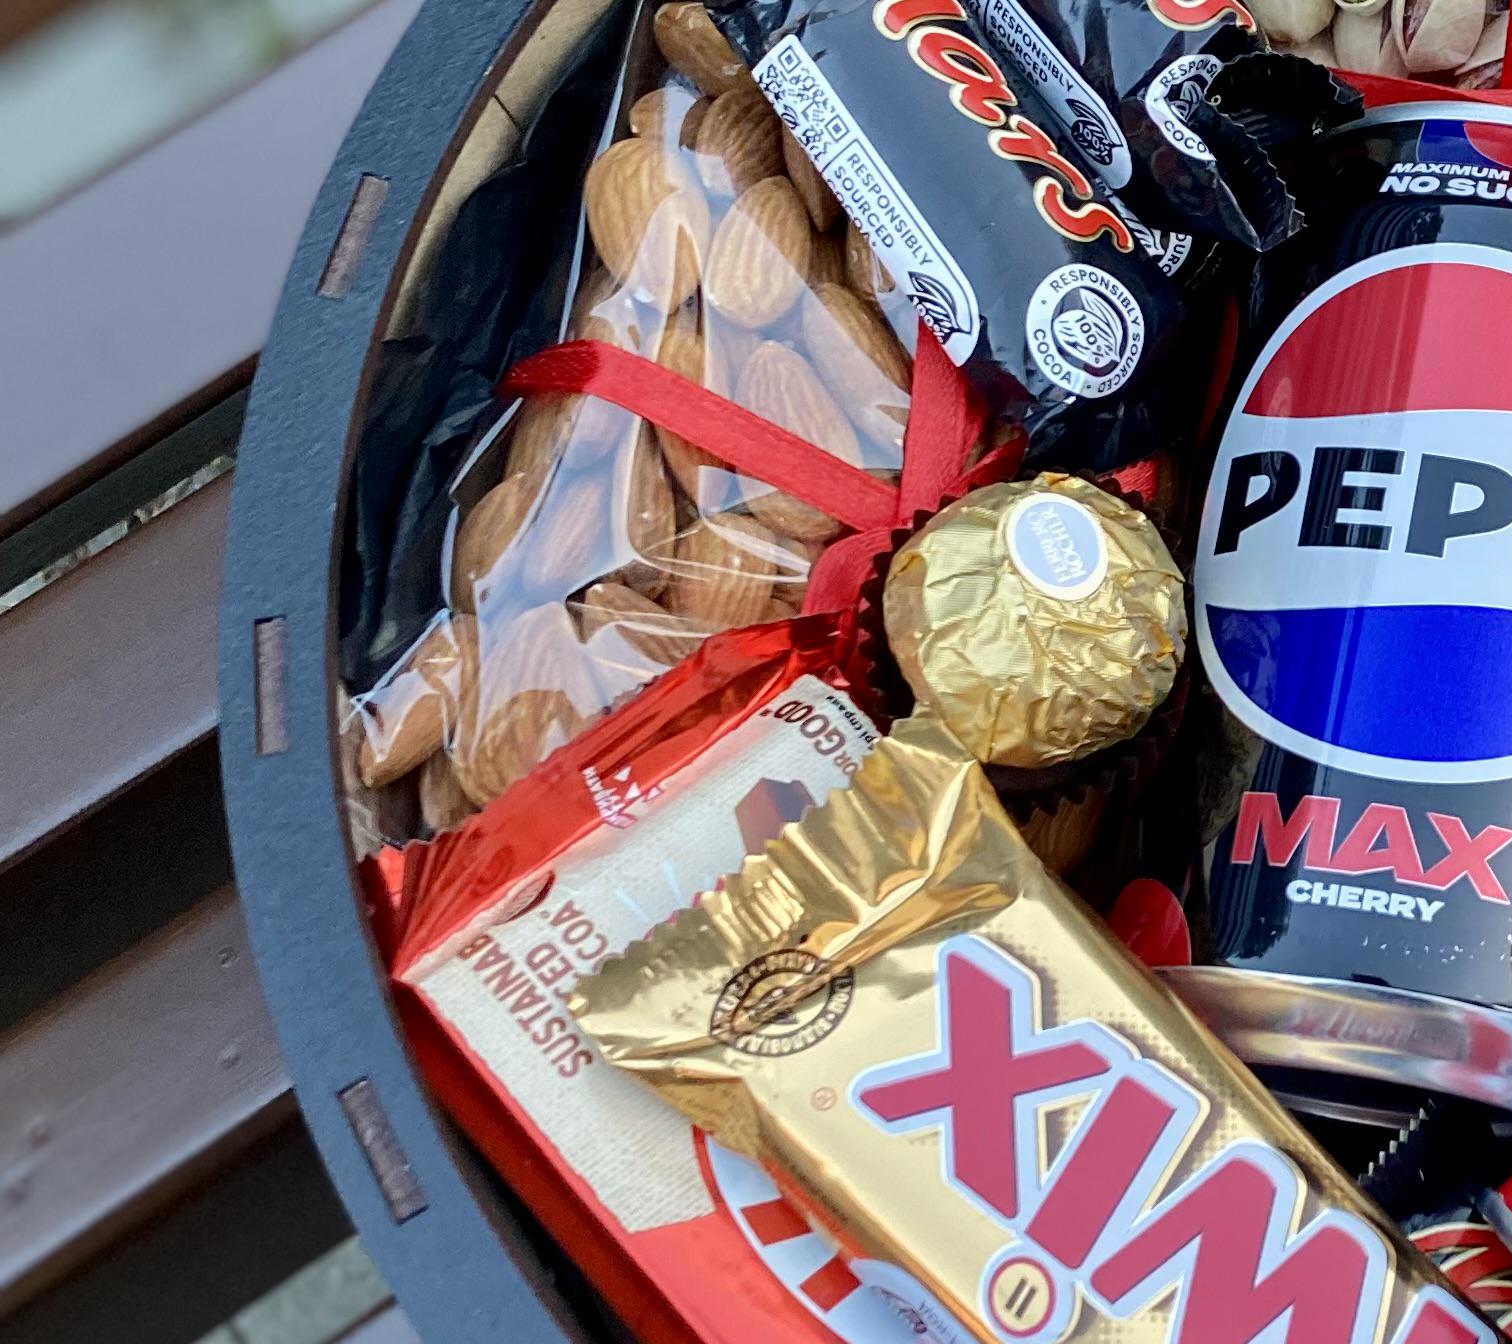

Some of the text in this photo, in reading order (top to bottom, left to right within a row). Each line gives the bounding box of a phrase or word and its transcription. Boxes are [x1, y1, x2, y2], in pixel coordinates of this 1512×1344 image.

[990, 17, 1048, 84] SOURCED
[1379, 175, 1440, 193] NO
[1389, 162, 1511, 182] MAXIMUM
[833, 165, 895, 249] SOURCED
[847, 153, 933, 266] RESPONSIBLY
[1033, 328, 1073, 385] COCOA
[1050, 269, 1141, 393] RESPONSIBLY SOURCED
[1286, 879, 1445, 923] CHERRY
